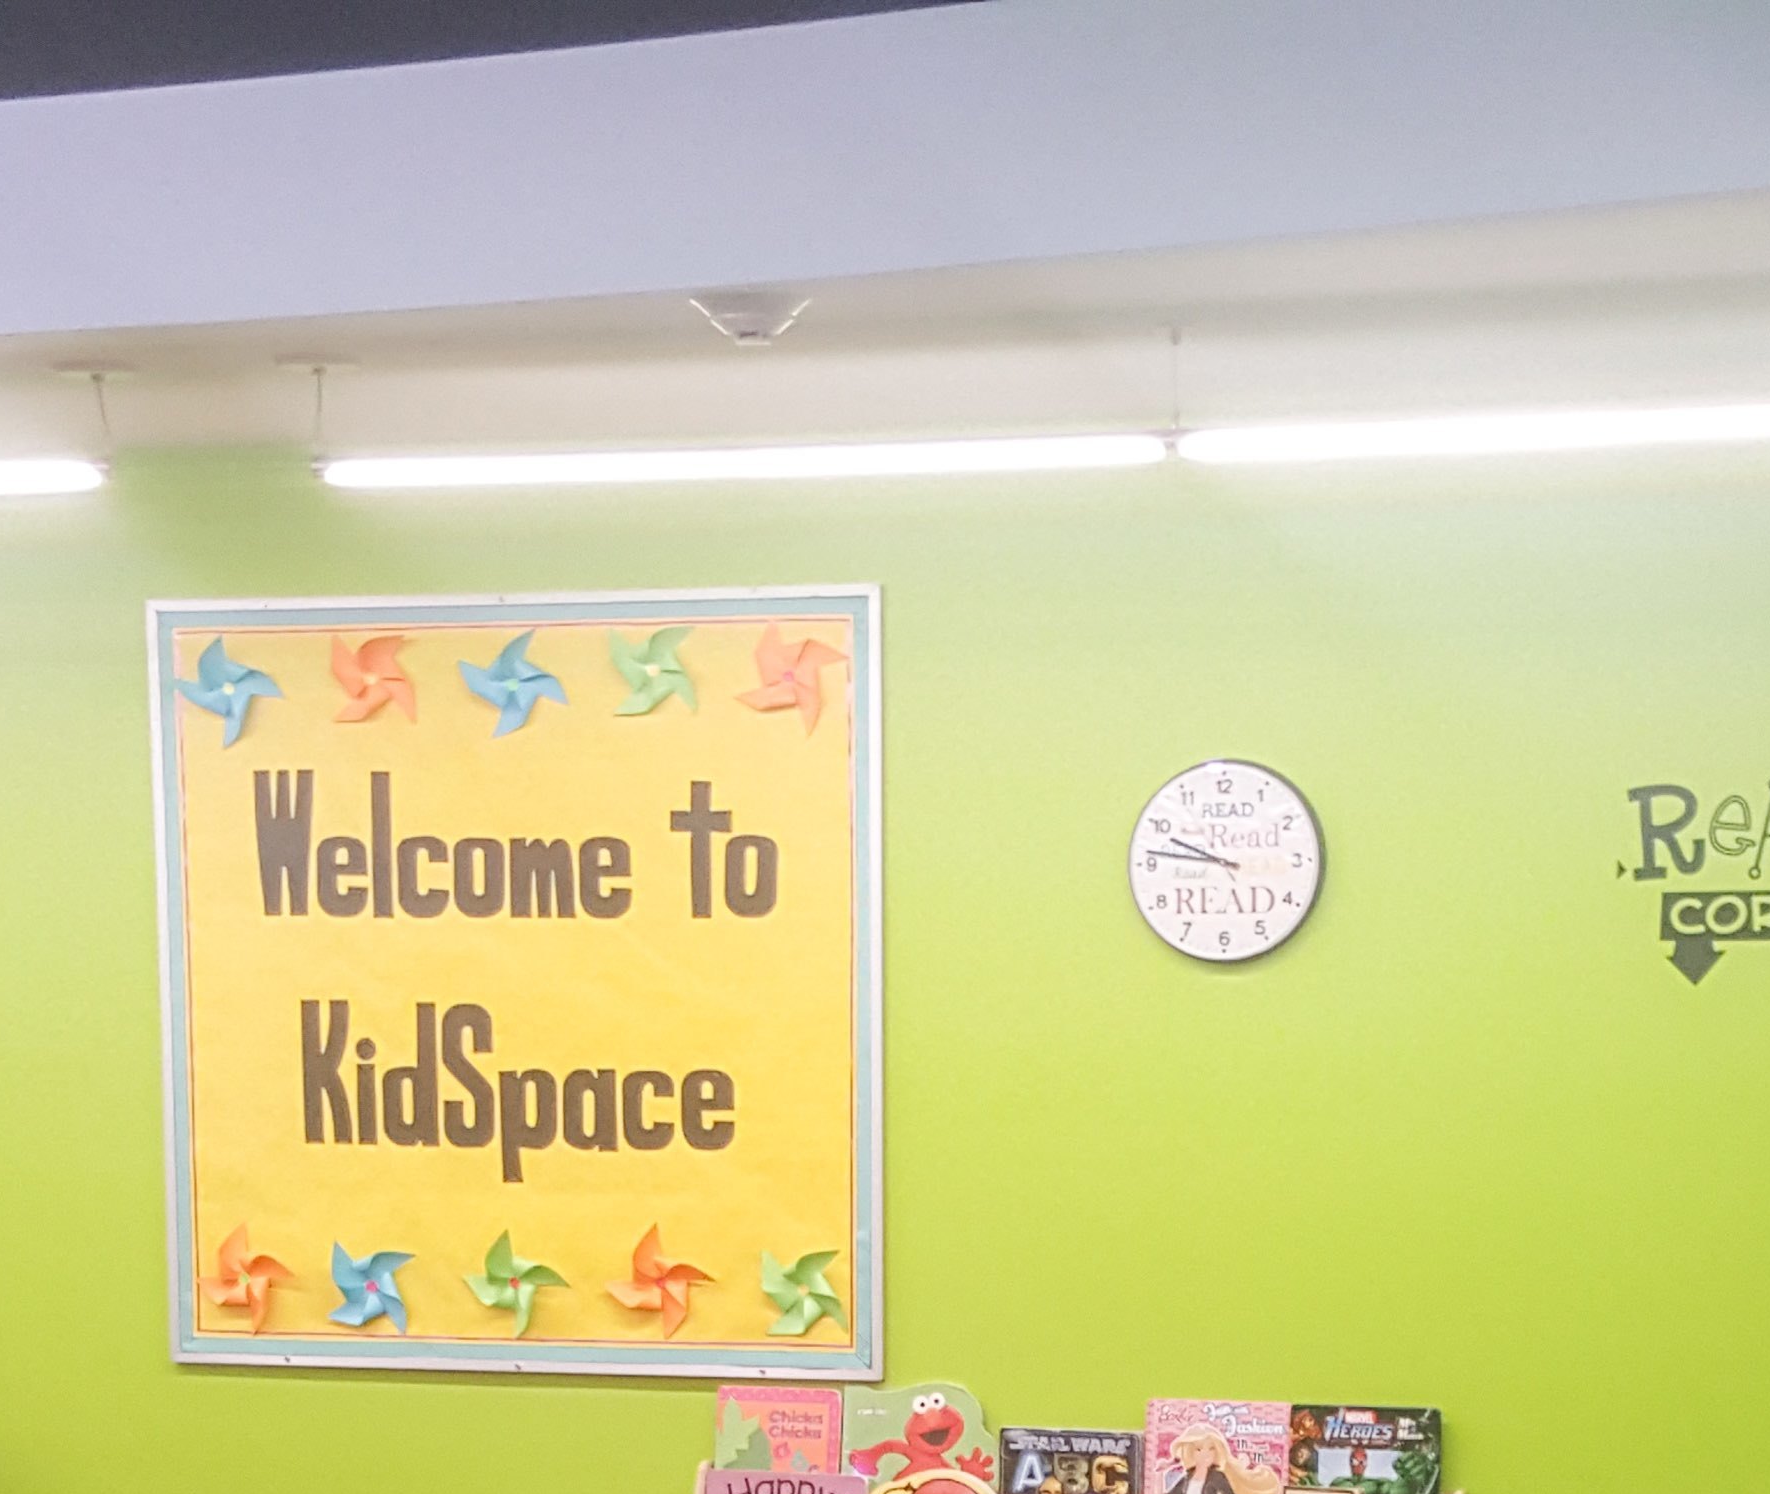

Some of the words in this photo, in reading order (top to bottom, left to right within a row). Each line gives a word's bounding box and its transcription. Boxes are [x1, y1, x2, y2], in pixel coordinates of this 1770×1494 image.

[1216, 779, 1233, 794] 12
[1181, 791, 1195, 806] 11
[1257, 789, 1265, 802] 1
[1202, 802, 1255, 818] READ
[1153, 819, 1171, 834] 10
[1282, 816, 1294, 830] 2
[1208, 822, 1280, 849] Read
[253, 768, 632, 919] Welcome
[669, 780, 778, 918] to
[1146, 857, 1157, 872] 9
[1291, 853, 1303, 868] 3
[1155, 895, 1167, 909] 8
[1174, 886, 1275, 915] READ
[1282, 891, 1293, 905] 4
[1182, 922, 1192, 937] 7
[1255, 920, 1266, 935] 5
[1218, 931, 1230, 946] 6
[300, 998, 735, 1183] KidSpace
[769, 1410, 823, 1425] Chicka
[1325, 1408, 1394, 1441] HEROES
[769, 1426, 822, 1440] Chicka
[1009, 1436, 1069, 1452] STAR
[1070, 1437, 1131, 1454] WARS
